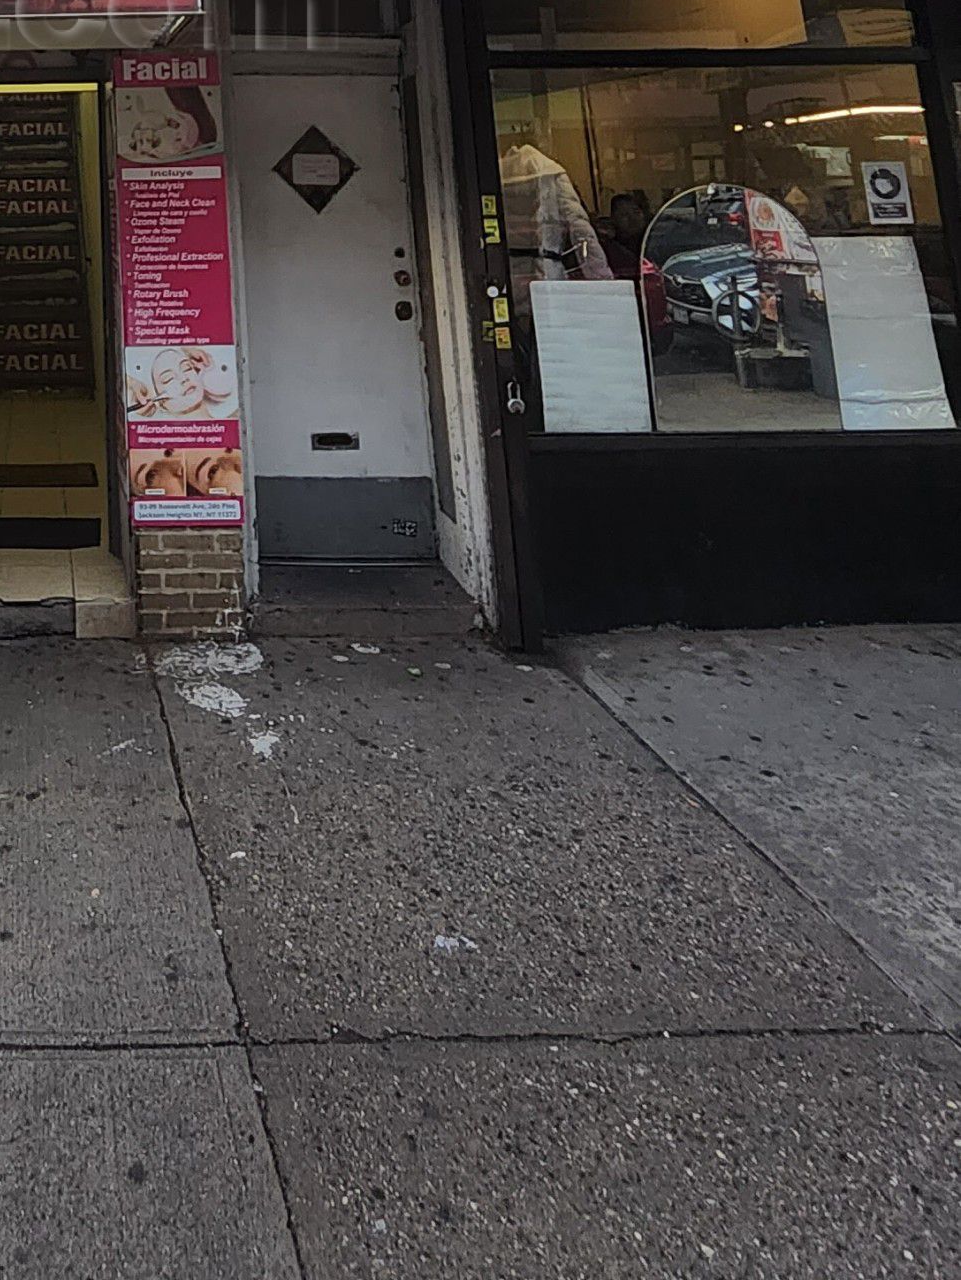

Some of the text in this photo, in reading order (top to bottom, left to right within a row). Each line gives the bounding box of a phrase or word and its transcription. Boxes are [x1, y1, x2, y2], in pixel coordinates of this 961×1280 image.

[122, 57, 208, 81] Facial
[150, 169, 194, 178] Incluye
[129, 182, 185, 191] Skin Analysis
[131, 217, 185, 226] Ozone Steam
[131, 236, 176, 244] Exfoliation
[181, 252, 223, 260] Extraction
[133, 289, 189, 299] Rotary Brush
[134, 308, 200, 318] High Frequency
[135, 326, 190, 336] Special Mask
